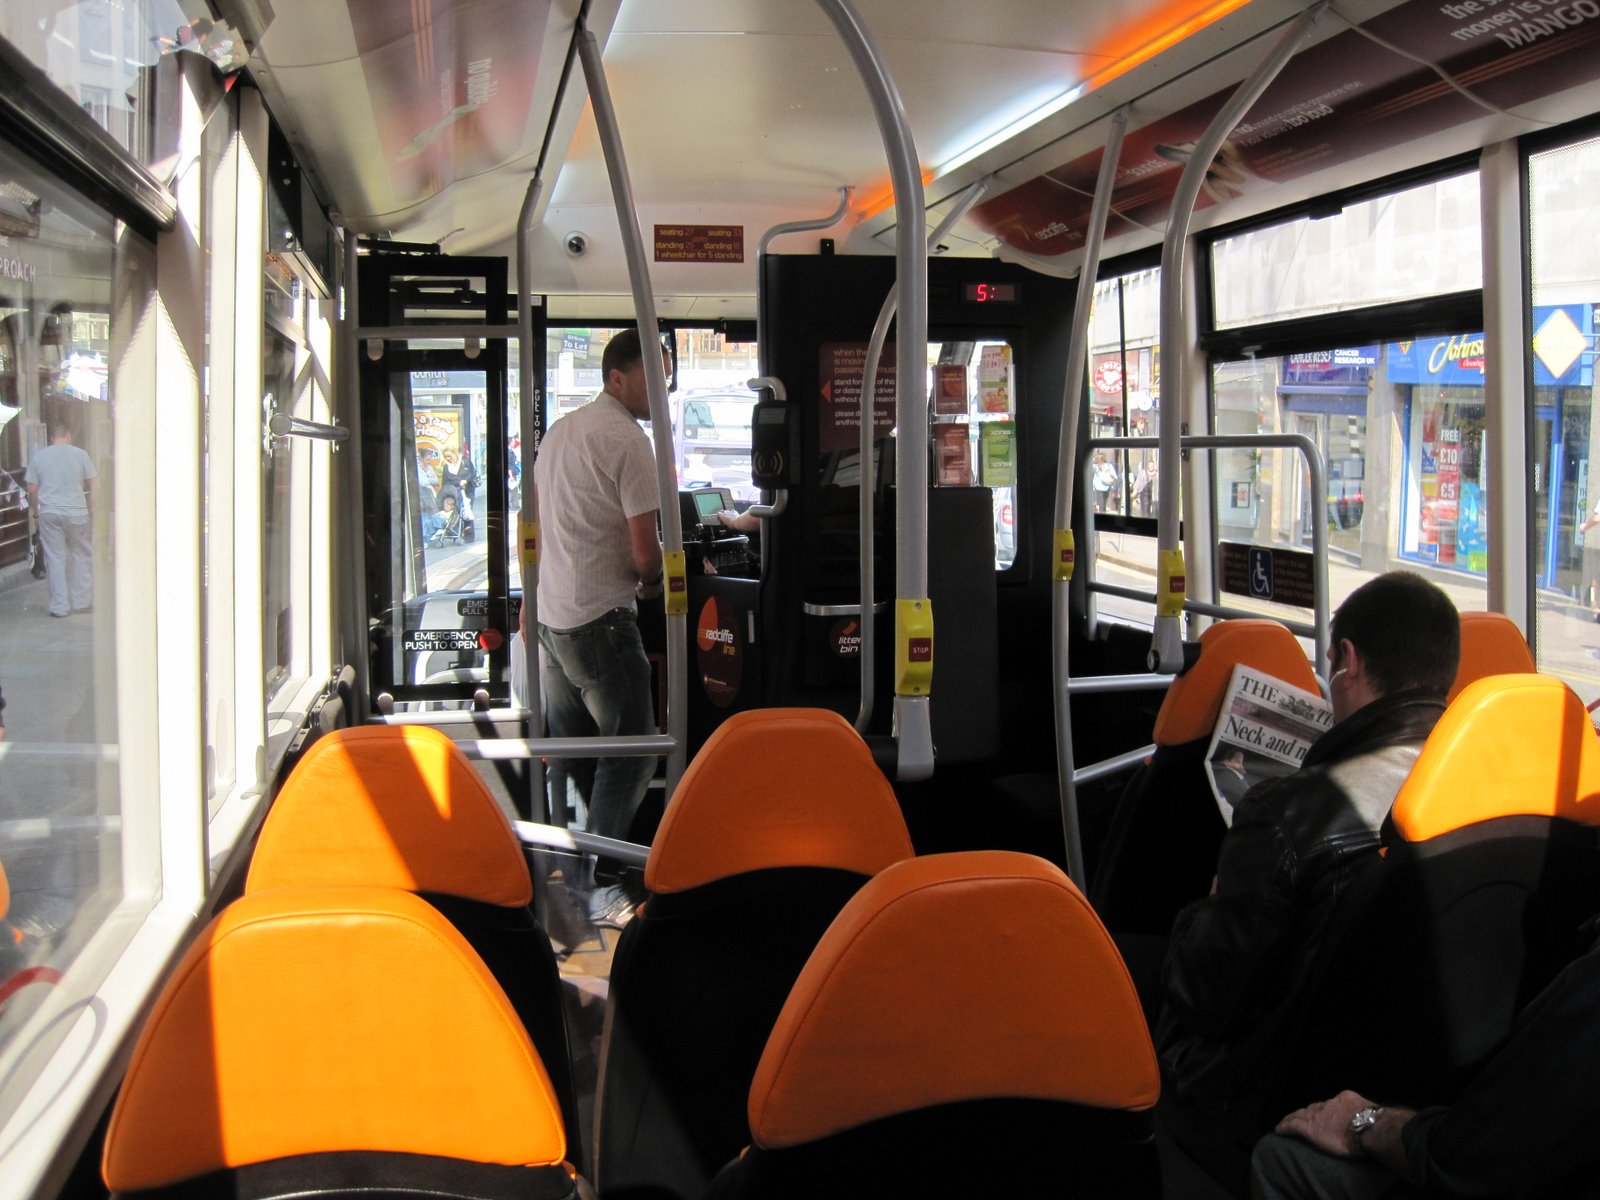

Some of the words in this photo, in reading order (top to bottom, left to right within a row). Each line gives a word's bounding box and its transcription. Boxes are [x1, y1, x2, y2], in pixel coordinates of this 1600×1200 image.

[1440, 0, 1485, 19] the
[1451, 9, 1523, 41] money
[1516, 1, 1542, 14] is
[1494, 1, 1600, 49] MANGO
[1306, 103, 1335, 121] loud
[703, 242, 732, 250] standing
[714, 252, 742, 260] standing
[563, 340, 573, 348] To
[574, 341, 588, 350] Let
[834, 410, 855, 418] please
[1440, 429, 1459, 442] FREE
[1440, 447, 1458, 464] £10
[1440, 482, 1456, 499] £5
[414, 631, 478, 640] EMERGENCY
[705, 628, 734, 644] radcliffe
[838, 636, 862, 645] litter
[405, 641, 431, 650] PUSH
[433, 641, 448, 650] TO
[449, 641, 478, 650] OPEN
[840, 645, 859, 653] bin
[912, 646, 929, 654] STOP
[1240, 675, 1279, 704] THE
[1225, 715, 1266, 745] Neck
[1266, 736, 1297, 756] and
